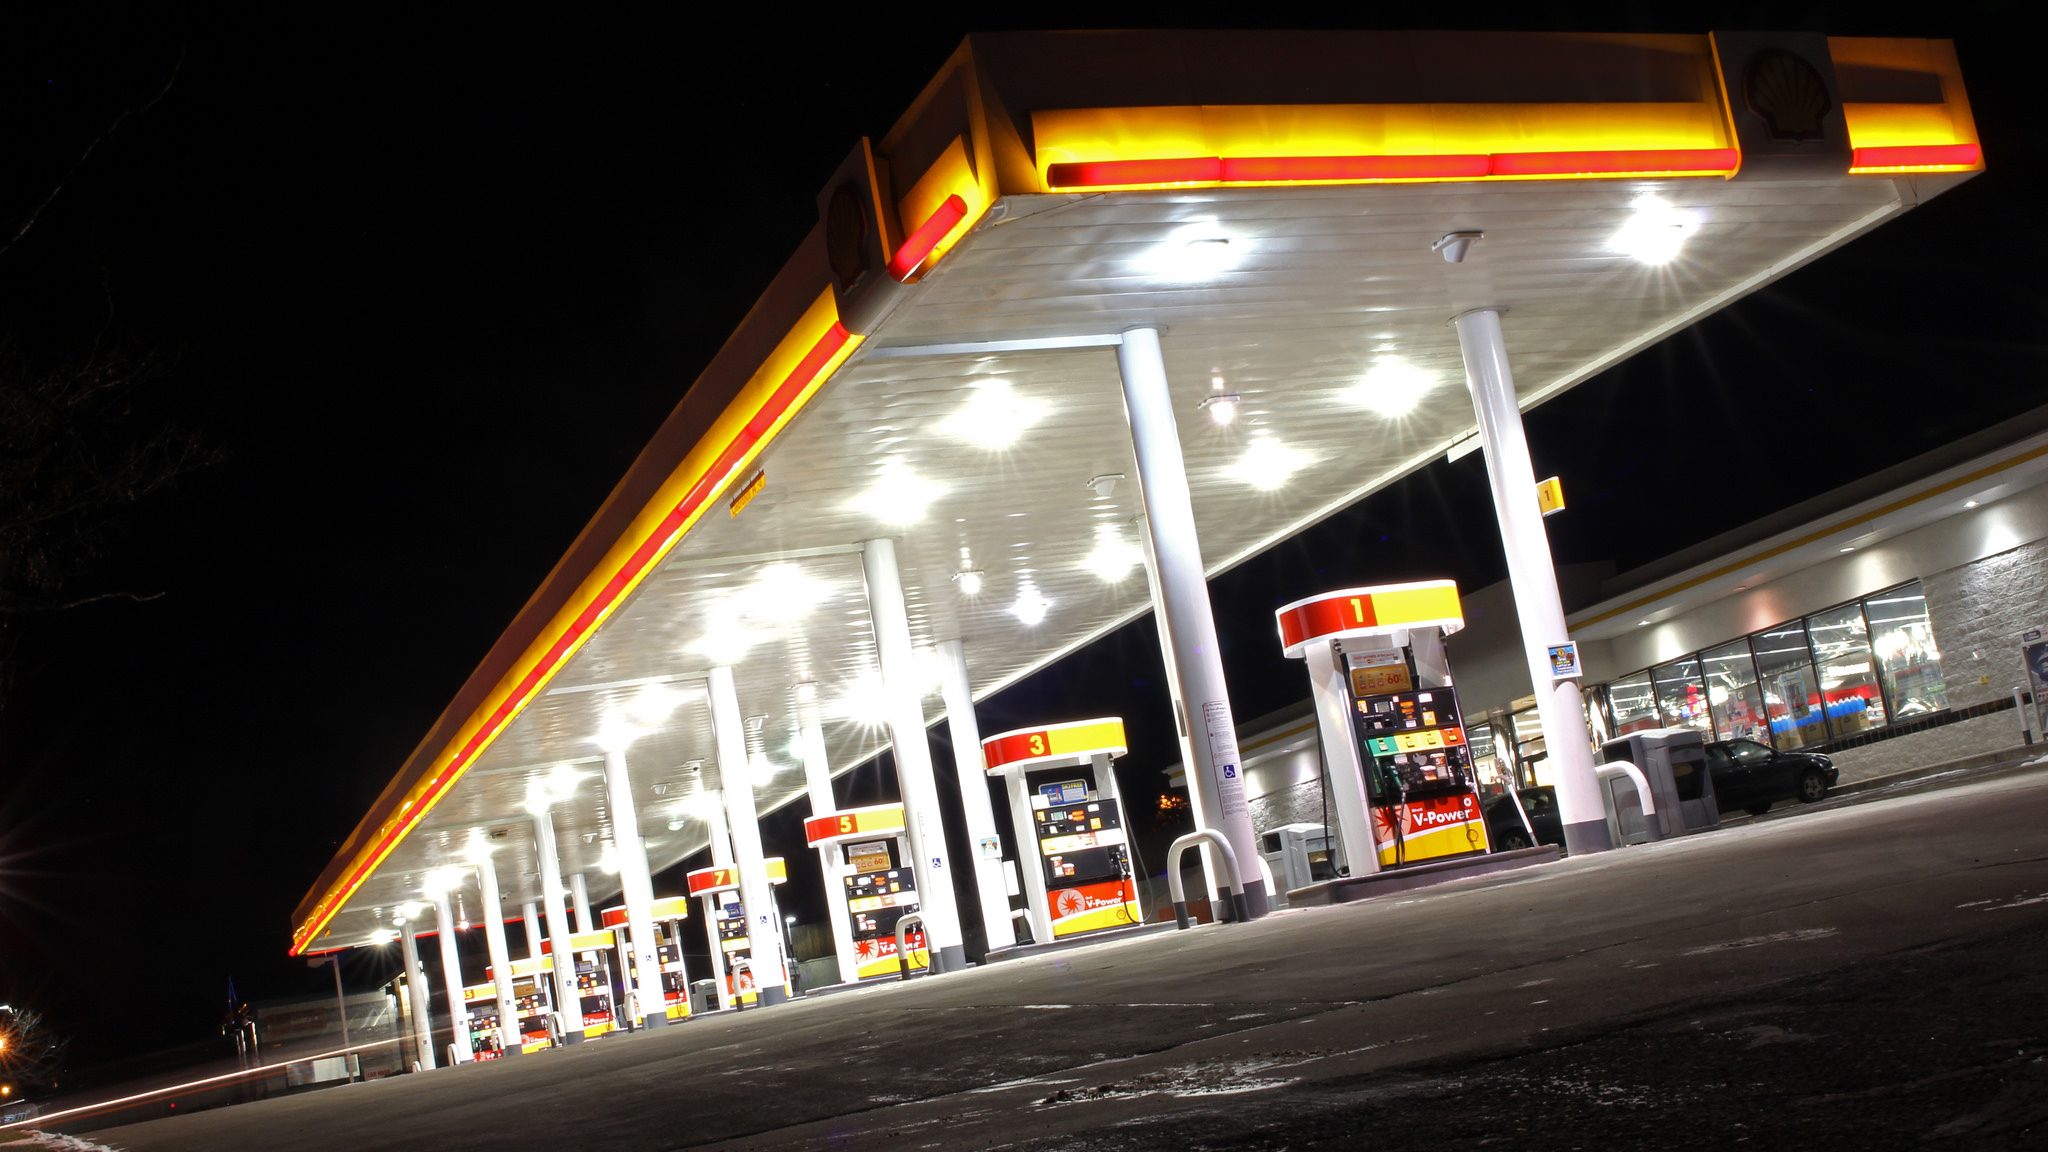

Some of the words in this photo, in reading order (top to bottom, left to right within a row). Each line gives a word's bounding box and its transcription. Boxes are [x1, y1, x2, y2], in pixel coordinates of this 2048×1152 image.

[1350, 598, 1363, 623] 1
[1029, 735, 1045, 755] 3
[840, 816, 852, 833] 5
[1412, 809, 1470, 827] V-Power
[714, 870, 726, 886] 7
[1085, 896, 1122, 908] V-Power
